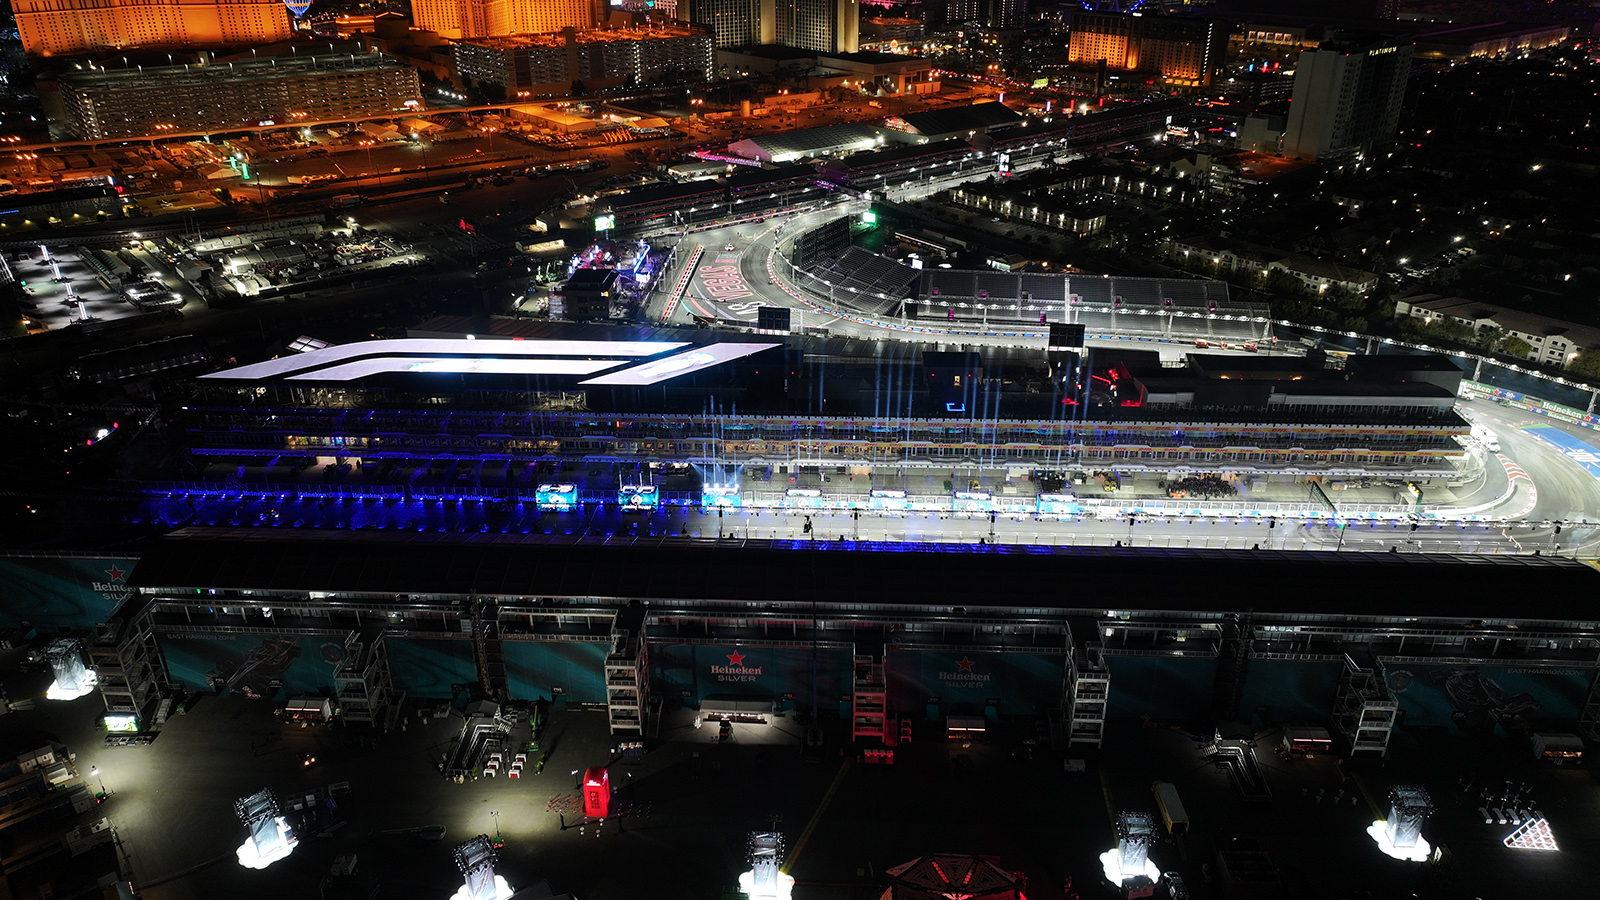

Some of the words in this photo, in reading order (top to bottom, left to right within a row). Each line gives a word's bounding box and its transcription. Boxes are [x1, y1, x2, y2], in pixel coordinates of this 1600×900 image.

[699, 266, 754, 302] VEGAS
[1542, 401, 1582, 418] Heineken
[711, 666, 762, 675] Heineken
[939, 672, 991, 681] Heineken
